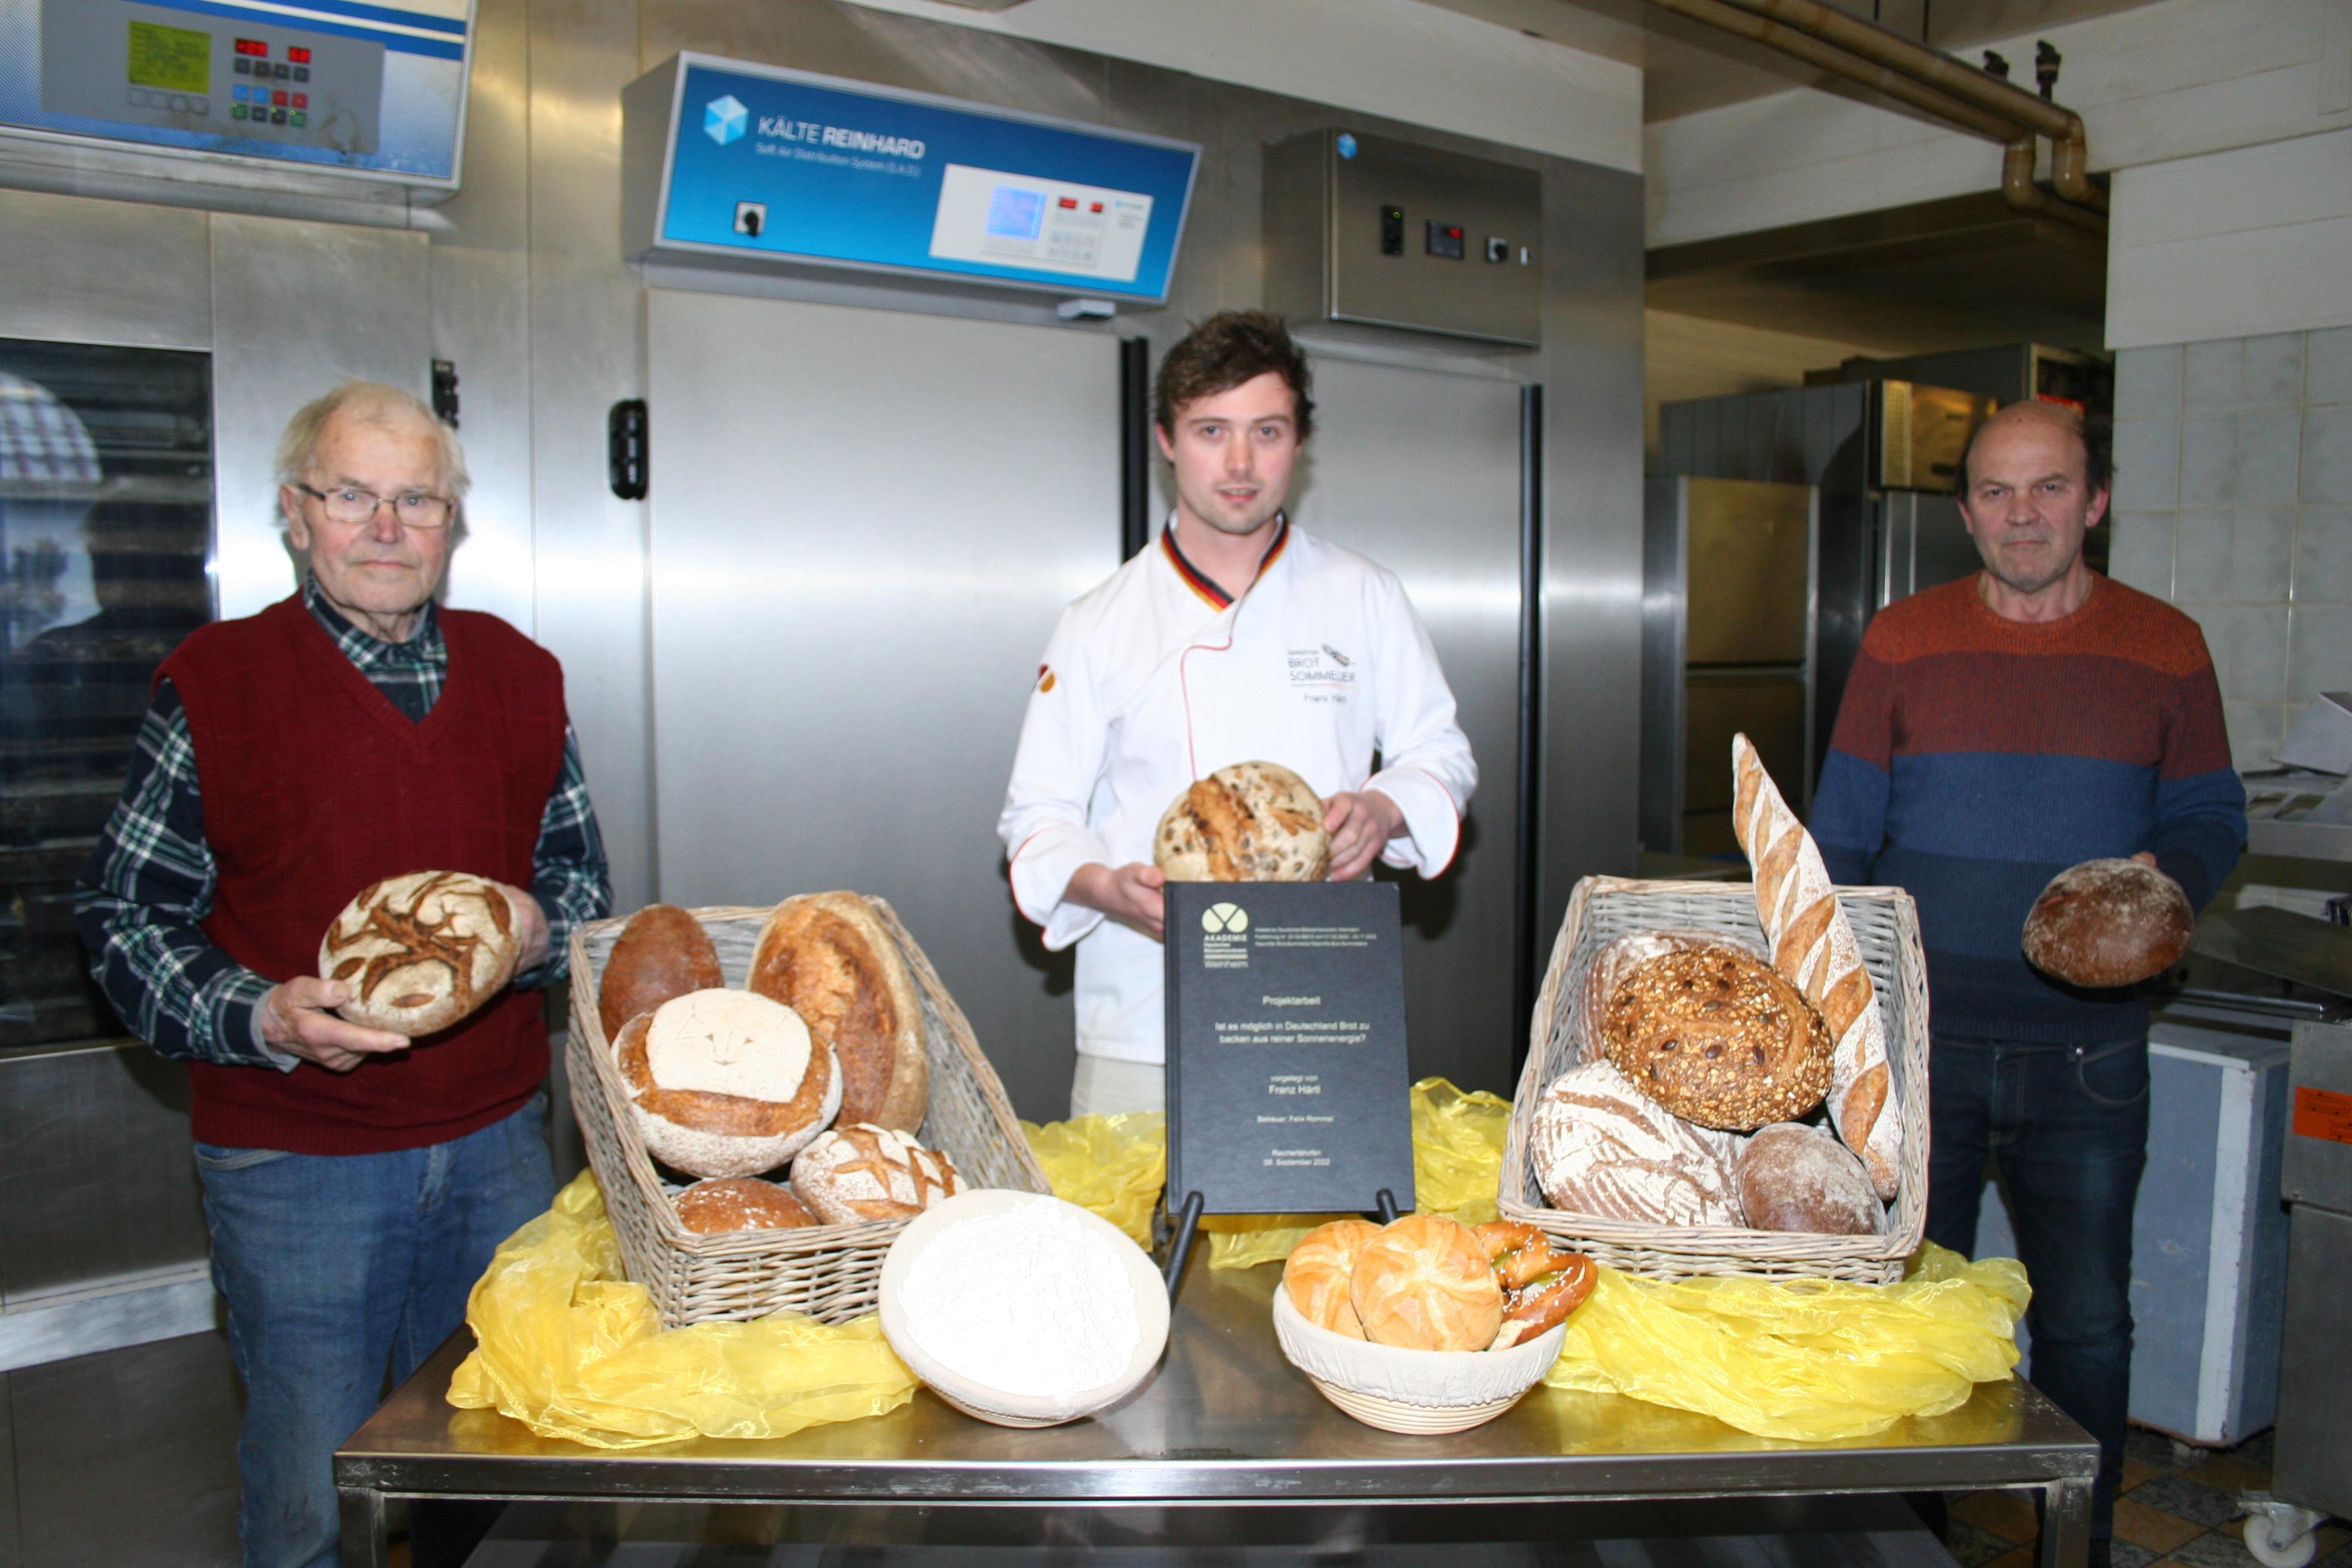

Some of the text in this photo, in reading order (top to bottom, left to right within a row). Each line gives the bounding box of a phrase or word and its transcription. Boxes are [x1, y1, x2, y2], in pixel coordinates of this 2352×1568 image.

[757, 115, 926, 160] KÄLTE REINHARD
[1287, 657, 1320, 668] BROT
[1262, 995, 1321, 1007] Projektarbeit
[1240, 1021, 1274, 1034] möglich
[1275, 1022, 1283, 1031] in
[1284, 1020, 1338, 1031] Deutschland
[1339, 1021, 1357, 1031] Brot
[1359, 1023, 1370, 1031] zu
[1218, 1034, 1251, 1043] backen
[1268, 1085, 1296, 1095] Franz
